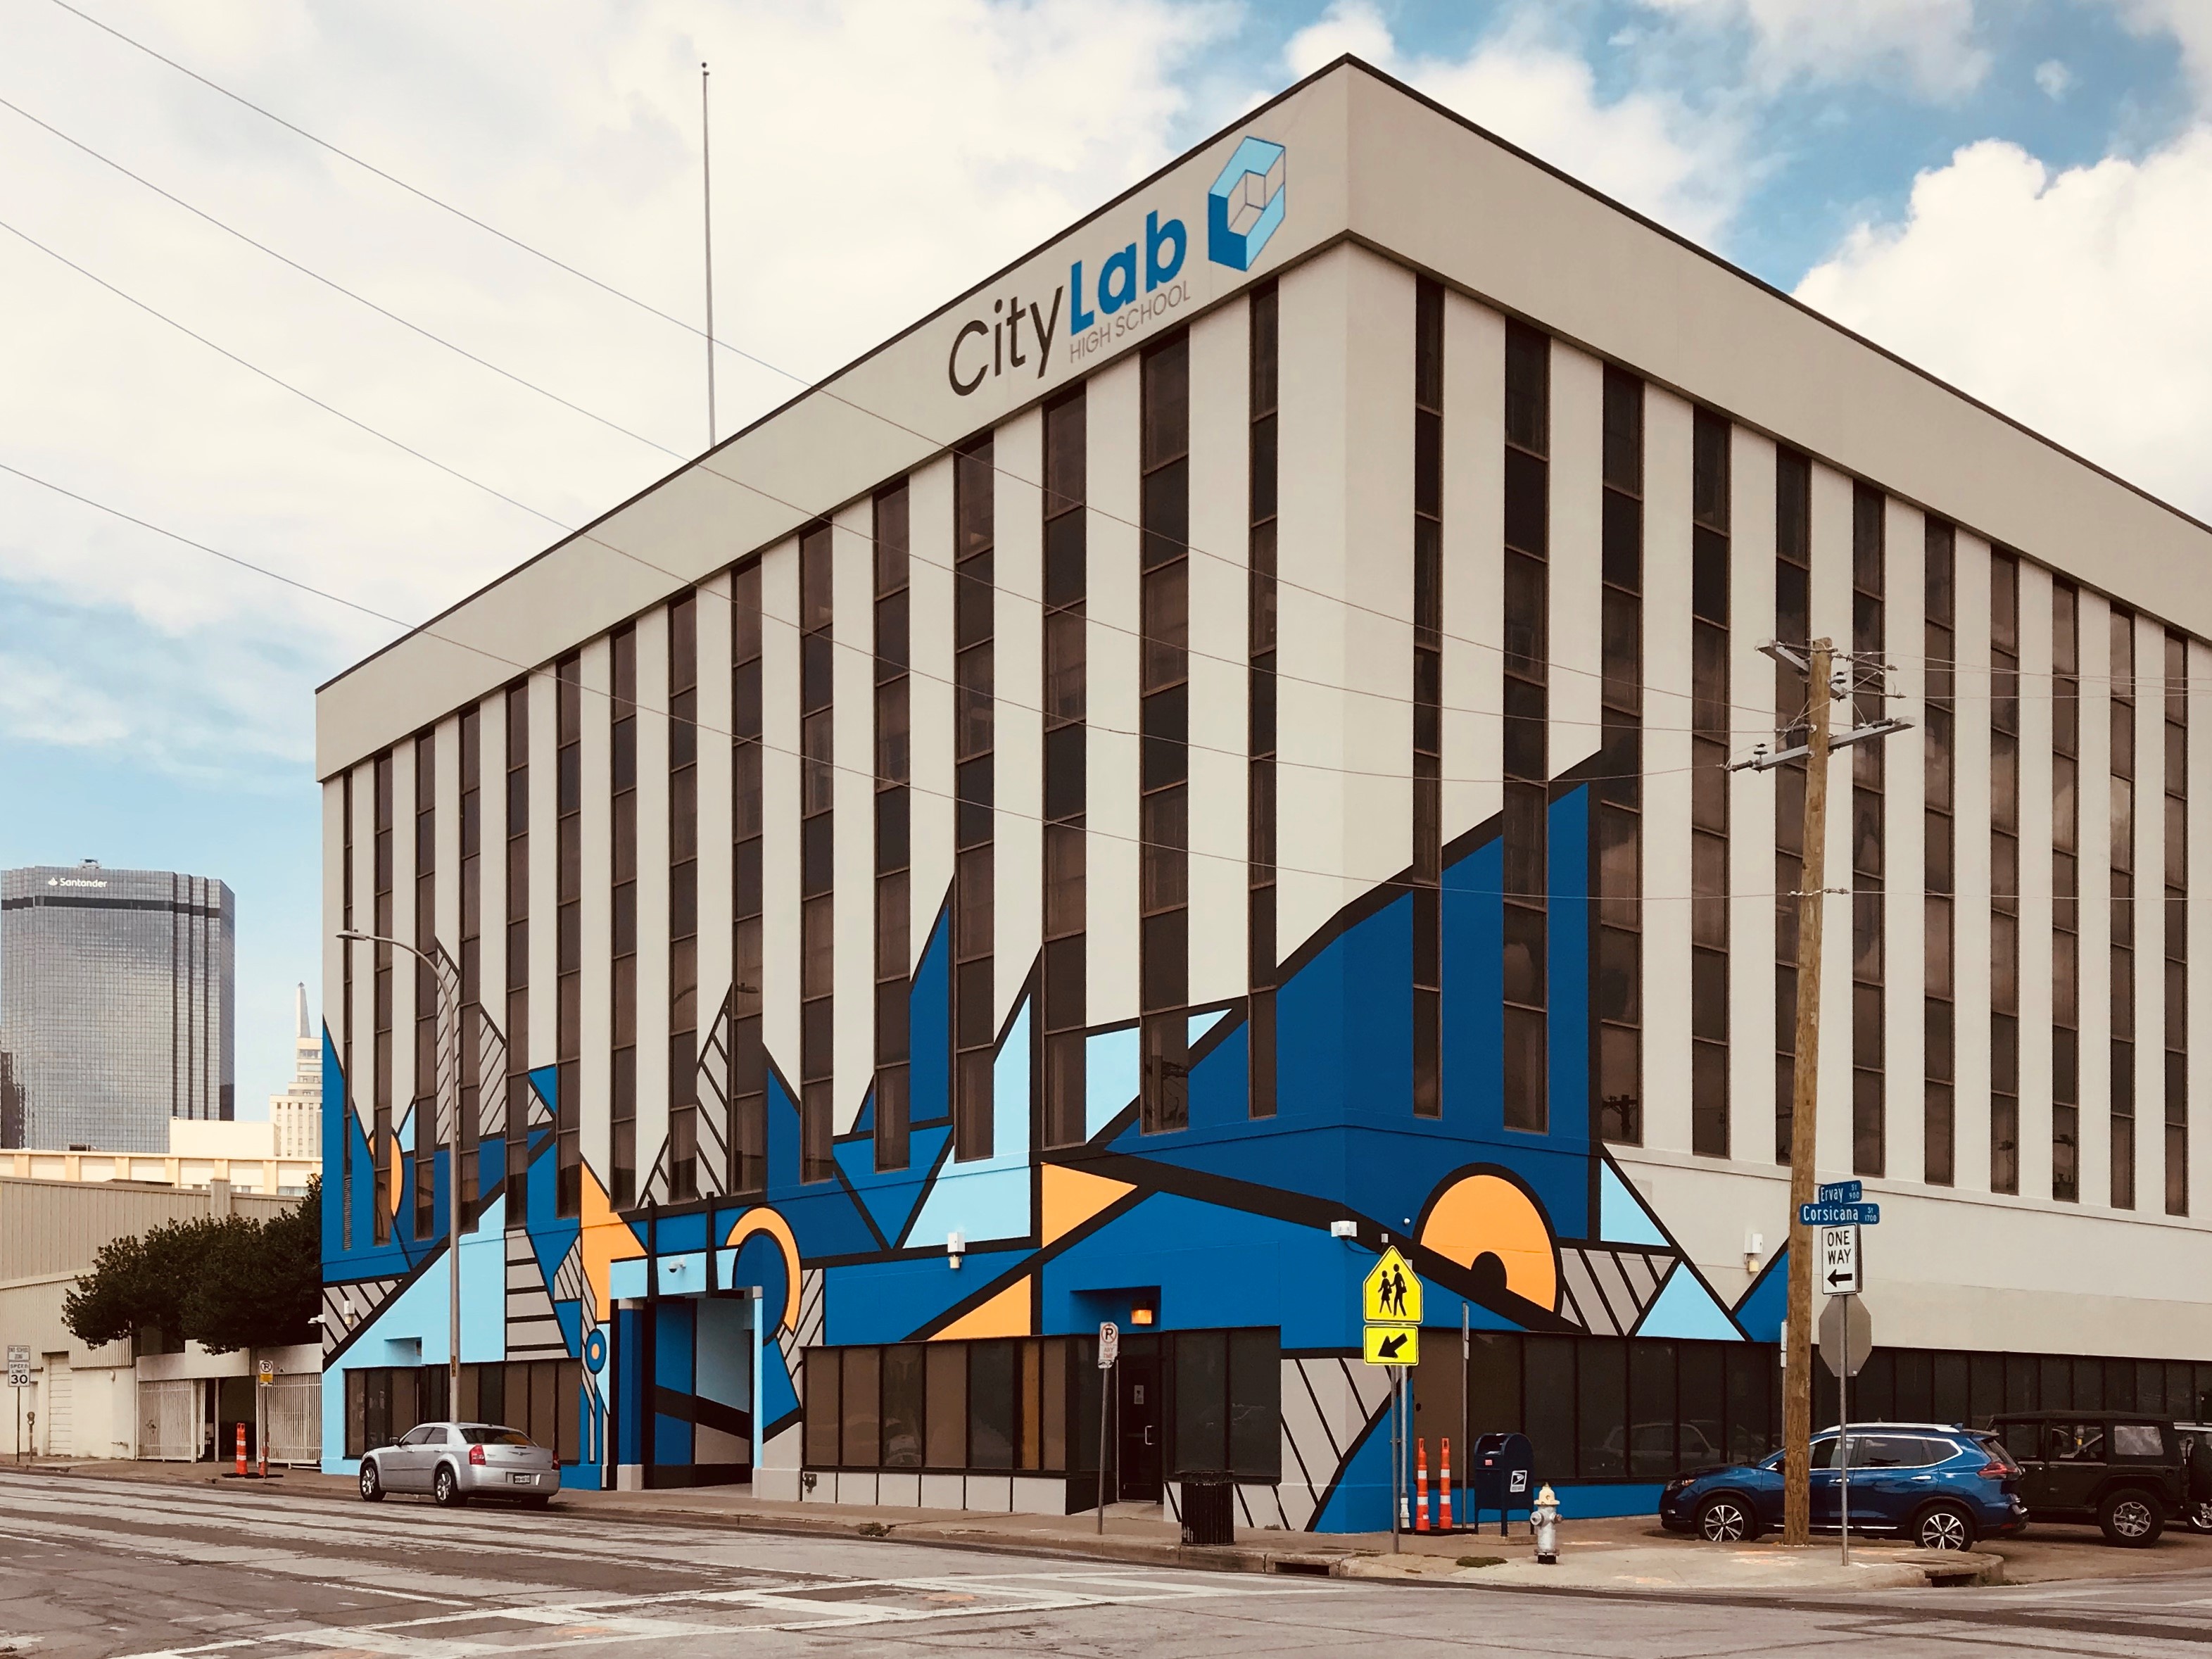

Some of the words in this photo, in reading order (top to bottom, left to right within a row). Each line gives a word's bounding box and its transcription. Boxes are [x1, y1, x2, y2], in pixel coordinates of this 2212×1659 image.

[1070, 322, 1111, 363] HIGH
[1116, 280, 1191, 338] SCHOOL
[60, 878, 107, 888] Santander
[1821, 1187, 1843, 1203] Ervay
[1803, 1205, 1859, 1221] Corsicana
[1827, 1230, 1850, 1247] ONE
[1828, 1248, 1852, 1266] WAY
[11, 1374, 27, 1384] 30
